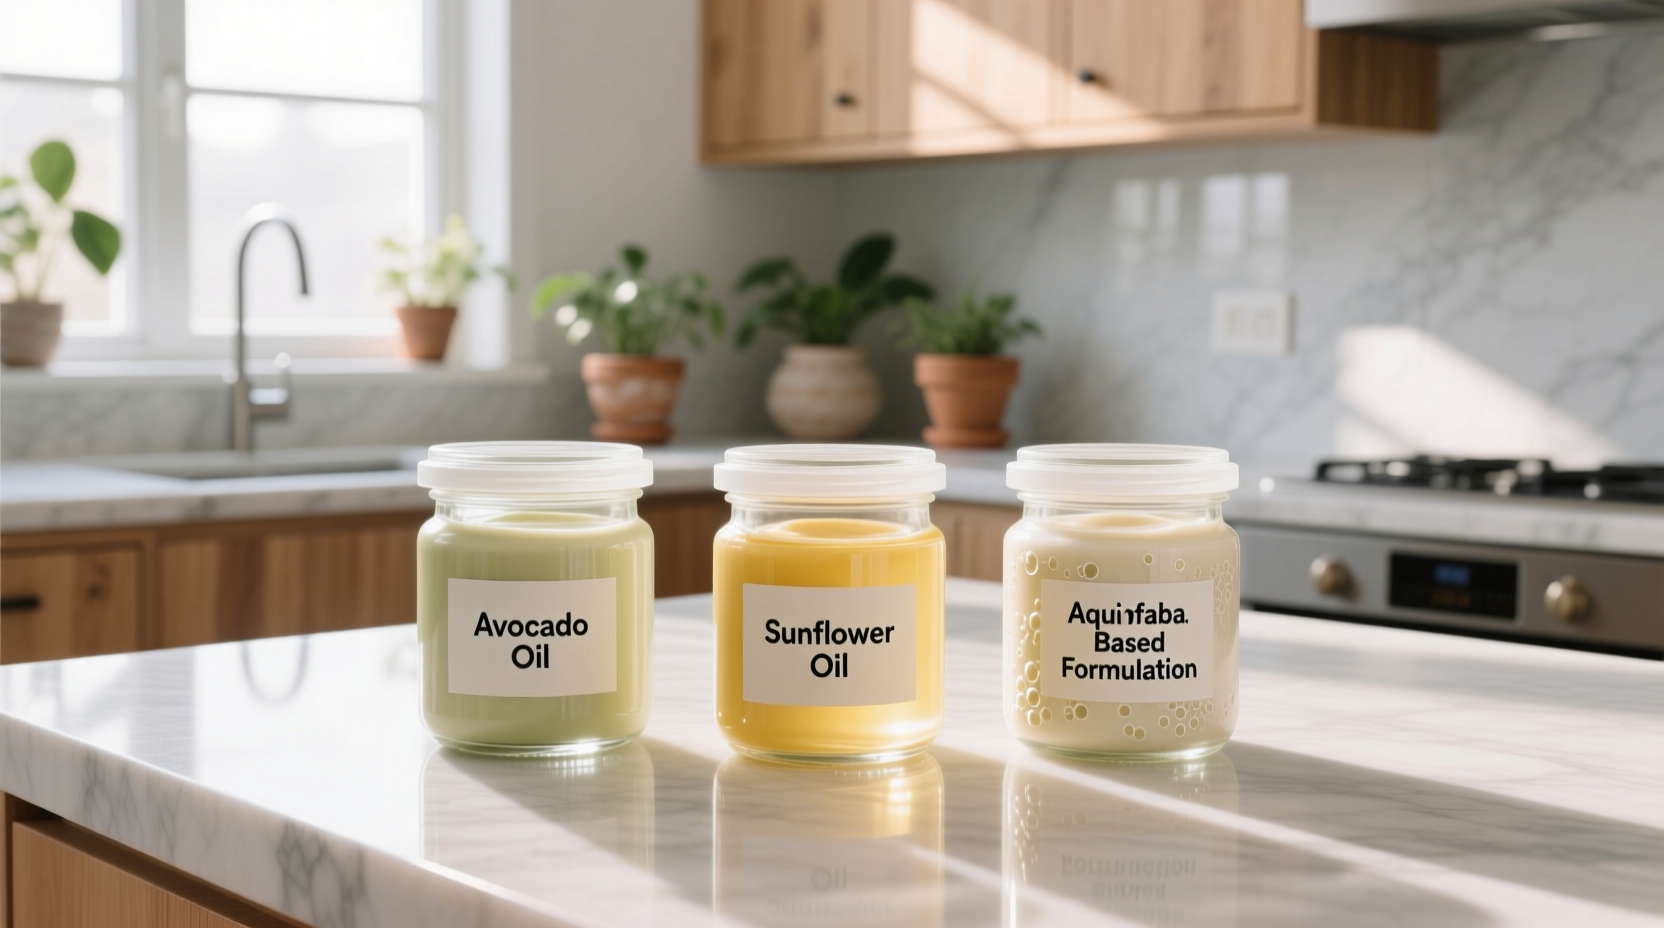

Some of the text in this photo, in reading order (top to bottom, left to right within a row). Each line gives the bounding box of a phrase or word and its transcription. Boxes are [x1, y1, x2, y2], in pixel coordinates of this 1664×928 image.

[473, 611, 589, 638] Avocado
[764, 618, 896, 646] Sunflower
[1094, 630, 1166, 654] Based
[511, 643, 550, 670] Oil
[810, 652, 849, 679] Oil
[1061, 656, 1198, 681] Formulation
